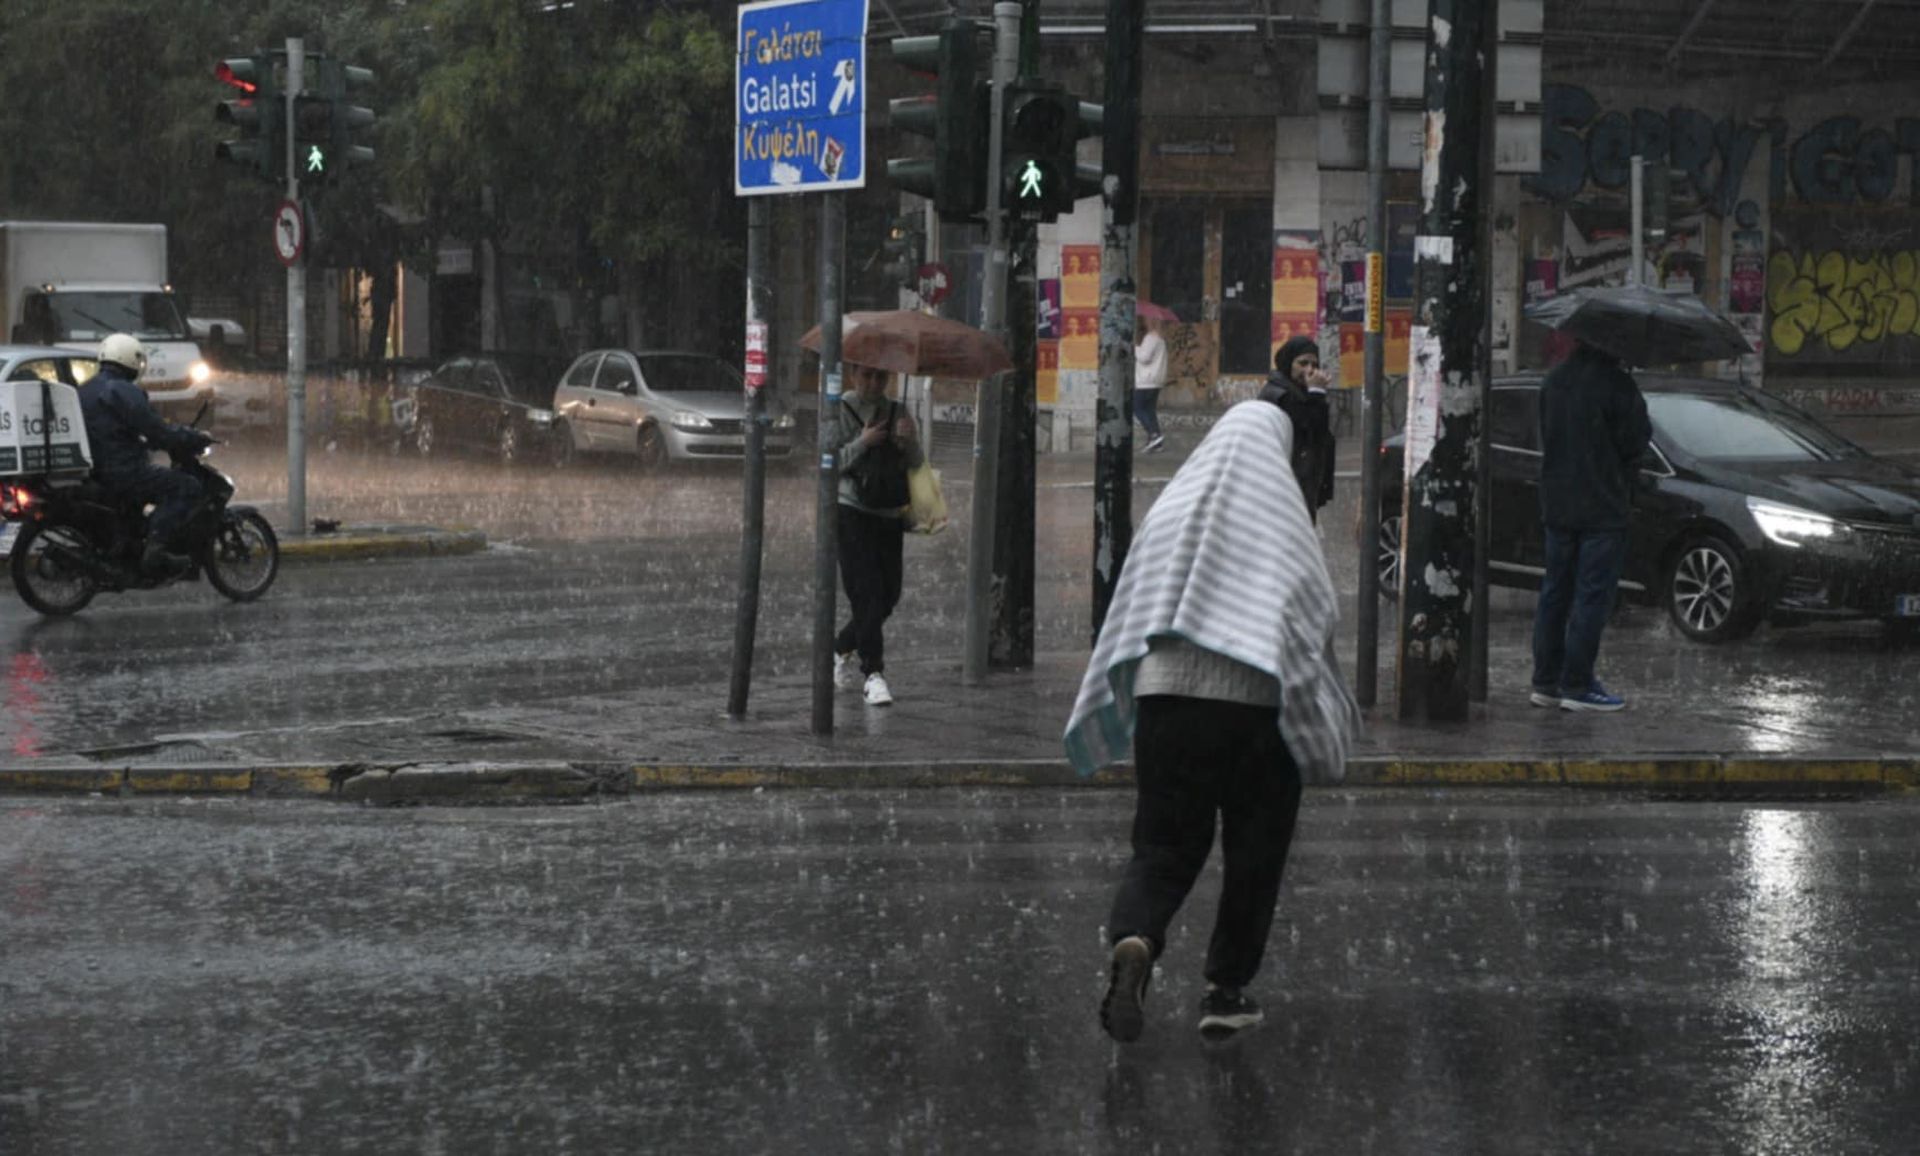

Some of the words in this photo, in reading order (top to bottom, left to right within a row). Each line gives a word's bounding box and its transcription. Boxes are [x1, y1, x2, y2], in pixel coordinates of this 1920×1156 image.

[743, 21, 822, 65] Γαλάτσι
[743, 71, 817, 114] Galatsi
[743, 118, 819, 165] Κυψέλη
